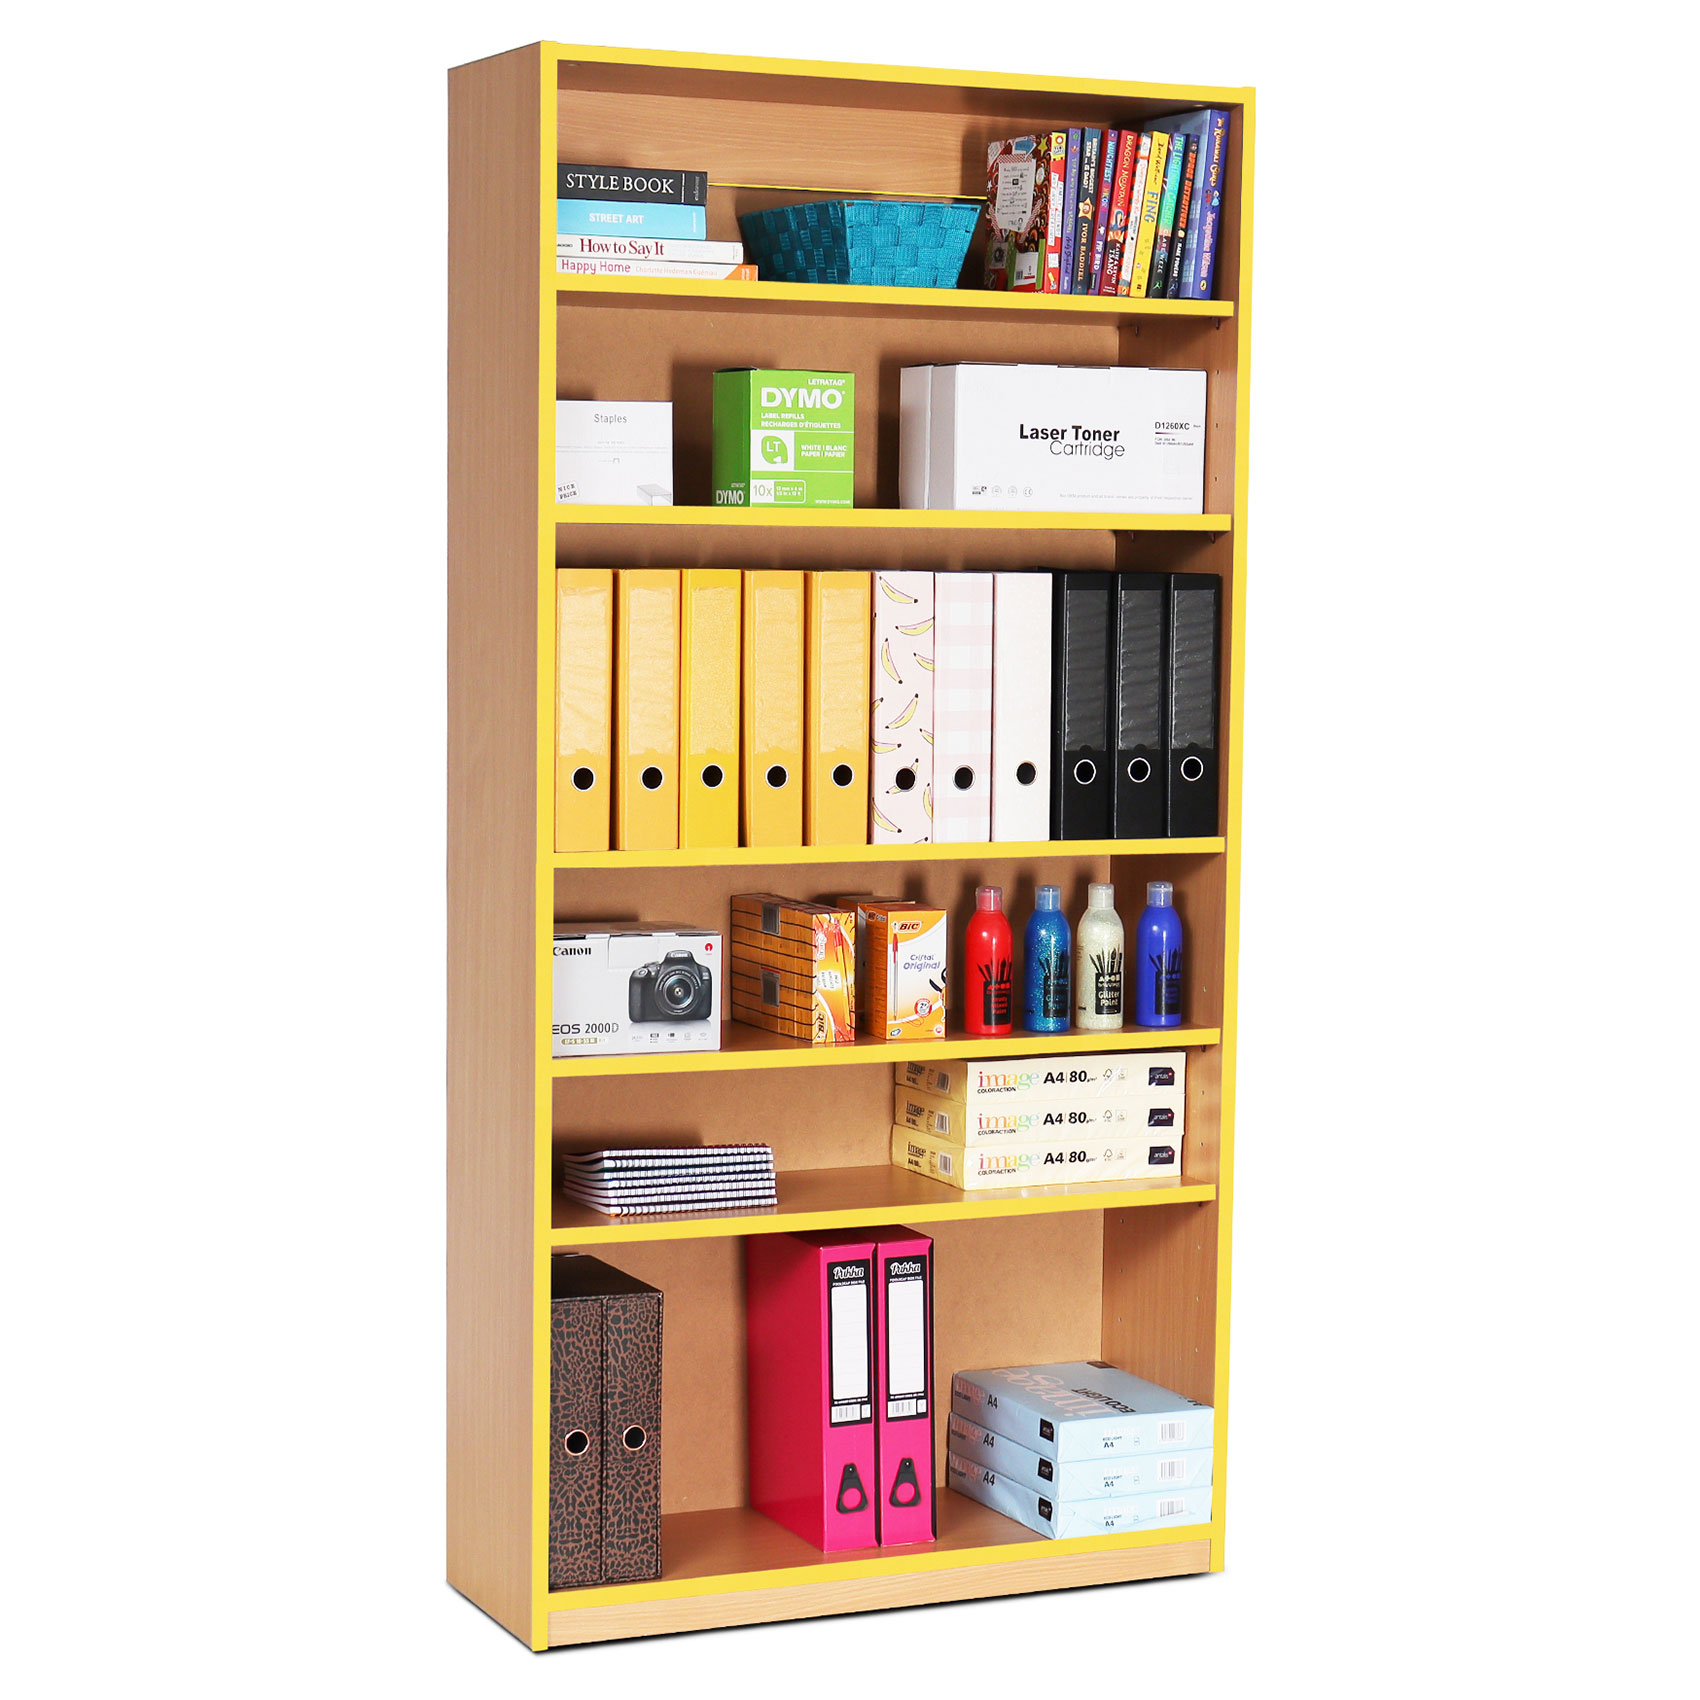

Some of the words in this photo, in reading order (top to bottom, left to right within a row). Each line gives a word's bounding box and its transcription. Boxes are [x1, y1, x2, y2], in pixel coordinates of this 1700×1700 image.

[1123, 135, 1134, 168] DRAGON
[1175, 137, 1183, 151] THE
[1104, 141, 1115, 182] NAUGHTIEST
[566, 173, 620, 190] STYLE
[623, 176, 674, 194] BOOK
[1118, 170, 1128, 207] MOUNTAIN
[1144, 191, 1158, 223] FING
[1166, 192, 1176, 225] CATCHER
[589, 213, 624, 223] STREET
[626, 214, 644, 224] ART
[580, 238, 611, 253] How
[613, 241, 626, 254] to
[629, 240, 652, 259] Say
[654, 241, 664, 255] It
[561, 259, 596, 275] Happy
[600, 261, 631, 273] Home
[1078, 246, 1086, 281] BADDIEL
[1107, 249, 1115, 274] TSANG
[1157, 253, 1165, 273] WEZE
[1201, 253, 1211, 277] Wilson
[761, 387, 843, 409] DYMO
[594, 413, 627, 424] Staples
[1155, 421, 1190, 430] D1260XC
[1020, 424, 1067, 440] Laser
[1072, 425, 1120, 441] Toner
[766, 441, 781, 452] LT
[1050, 440, 1125, 460] Cartridge
[558, 484, 575, 492] NICE
[559, 491, 577, 499] PRICE
[753, 485, 773, 497] 10x
[715, 490, 744, 504] DYMO
[553, 946, 592, 956] Canon
[903, 961, 940, 972] Original
[1098, 991, 1119, 999] Glitter
[552, 1024, 580, 1035] EOS
[585, 1023, 619, 1034] 2000D
[977, 1071, 1040, 1090] image
[1043, 1072, 1064, 1084] A4
[1069, 1070, 1087, 1083] 80
[977, 1113, 1040, 1132] image
[1043, 1113, 1063, 1125] A4
[1068, 1112, 1087, 1124] 80
[977, 1153, 1040, 1172] image
[1044, 1152, 1064, 1165] A4
[1068, 1151, 1087, 1163] 80
[978, 1168, 1016, 1176] COLORACTION
[833, 1266, 864, 1280] Pukka
[890, 1262, 921, 1276] Pukka
[987, 1394, 998, 1409] A4
[1071, 1388, 1136, 1413] ECOLIGHT
[983, 1433, 995, 1448] A4
[982, 1471, 995, 1486] A4
